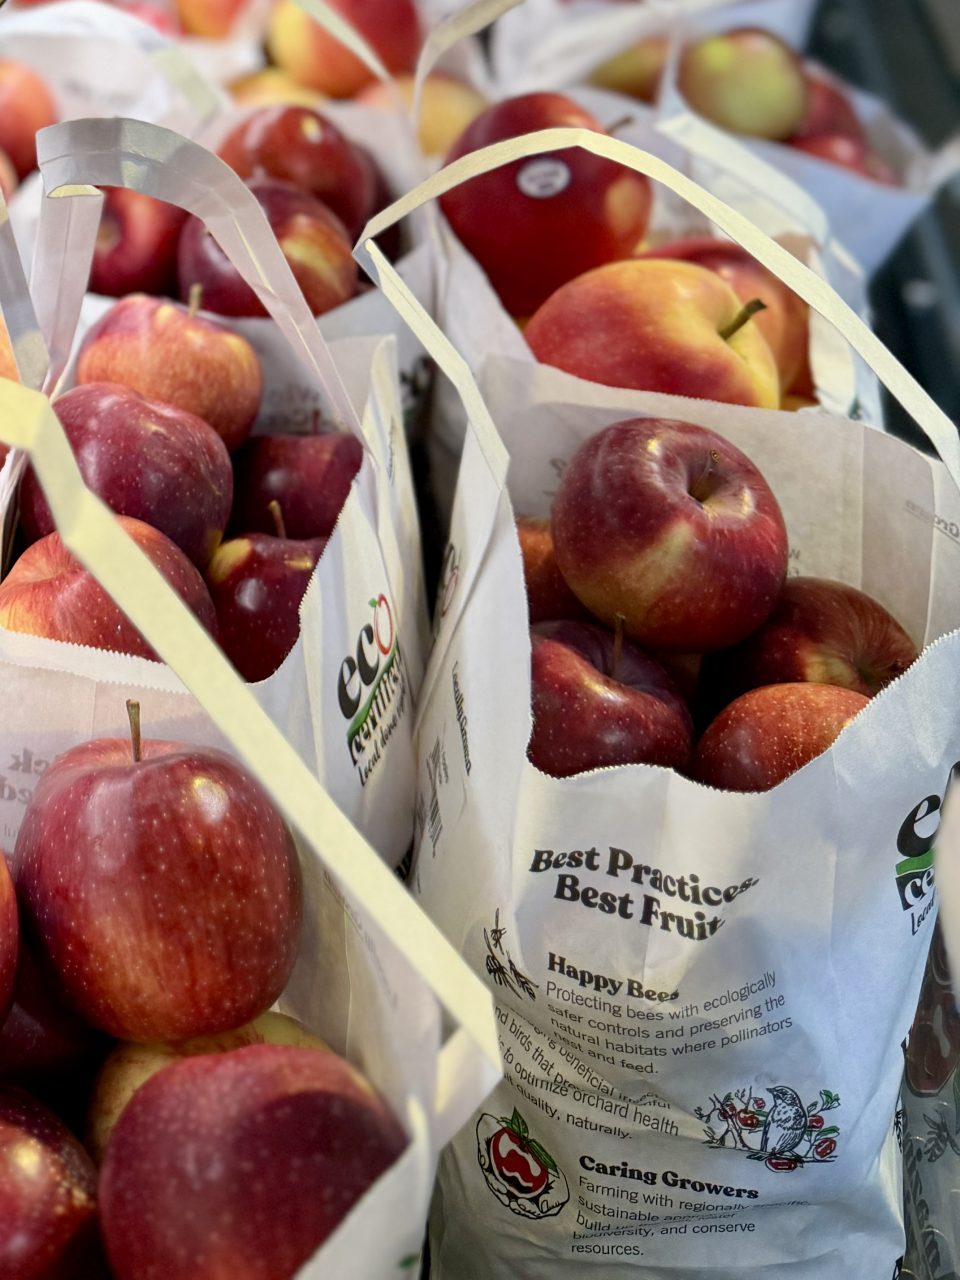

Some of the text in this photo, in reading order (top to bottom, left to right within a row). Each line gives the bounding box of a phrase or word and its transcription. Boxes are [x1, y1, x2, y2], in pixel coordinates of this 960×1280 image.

[337, 593, 394, 720] eco
[358, 742, 382, 787] Local
[528, 846, 600, 873] Best
[553, 873, 634, 920] Best
[546, 970, 777, 1022] Protecting bees with ecologically
[547, 951, 680, 1003] Happy Bees
[547, 992, 786, 1040] safer controls and preserving the
[550, 1017, 600, 1047] natural
[604, 1038, 668, 1058] habitats
[671, 1037, 717, 1057] where
[720, 1015, 793, 1049] pollinators
[494, 1005, 509, 1025] nd
[509, 1018, 534, 1053] birds
[531, 1045, 556, 1077] that
[587, 1047, 616, 1066] and
[620, 1055, 659, 1075] feed.
[503, 1046, 514, 1065] to
[514, 1061, 569, 1098] optimize
[572, 1087, 629, 1119] orchard
[633, 1104, 680, 1137] health
[516, 1081, 633, 1140] quality, naturally.
[579, 1155, 759, 1200] Caring Growers
[579, 1175, 639, 1204] Farming
[642, 1191, 673, 1208] with
[678, 1199, 750, 1213] regionally
[576, 1210, 611, 1231] build
[578, 1194, 659, 1222] sustainable
[660, 1222, 687, 1235] and
[692, 1221, 756, 1235] conserve
[571, 1243, 645, 1256] resources.
